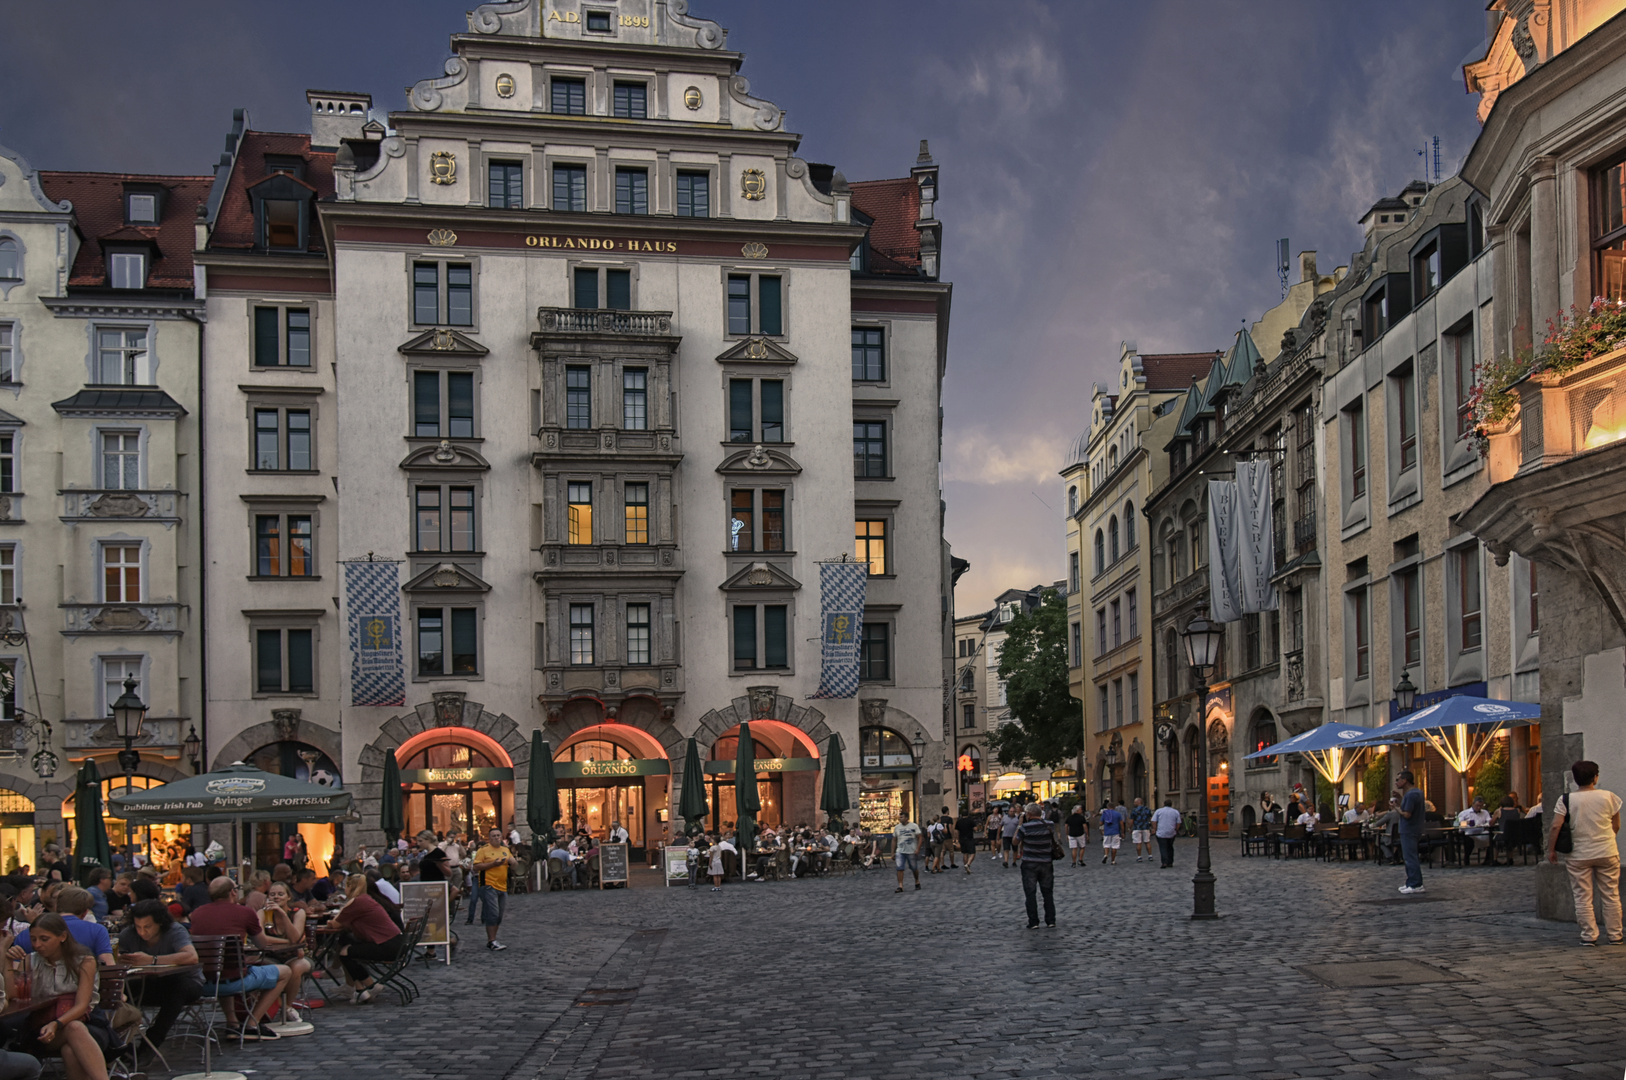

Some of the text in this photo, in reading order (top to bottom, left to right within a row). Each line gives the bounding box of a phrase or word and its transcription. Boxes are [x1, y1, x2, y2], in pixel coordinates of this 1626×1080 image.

[548, 10, 649, 28] A.D. 1899
[525, 235, 677, 252] ORLANDO HAUS
[581, 764, 637, 775] ORLANDO
[429, 771, 473, 780] ORLANDO
[123, 801, 204, 811] Dubliner Irish Pub
[213, 796, 253, 807] Ayinger
[272, 797, 331, 806] SPORTSBAR
